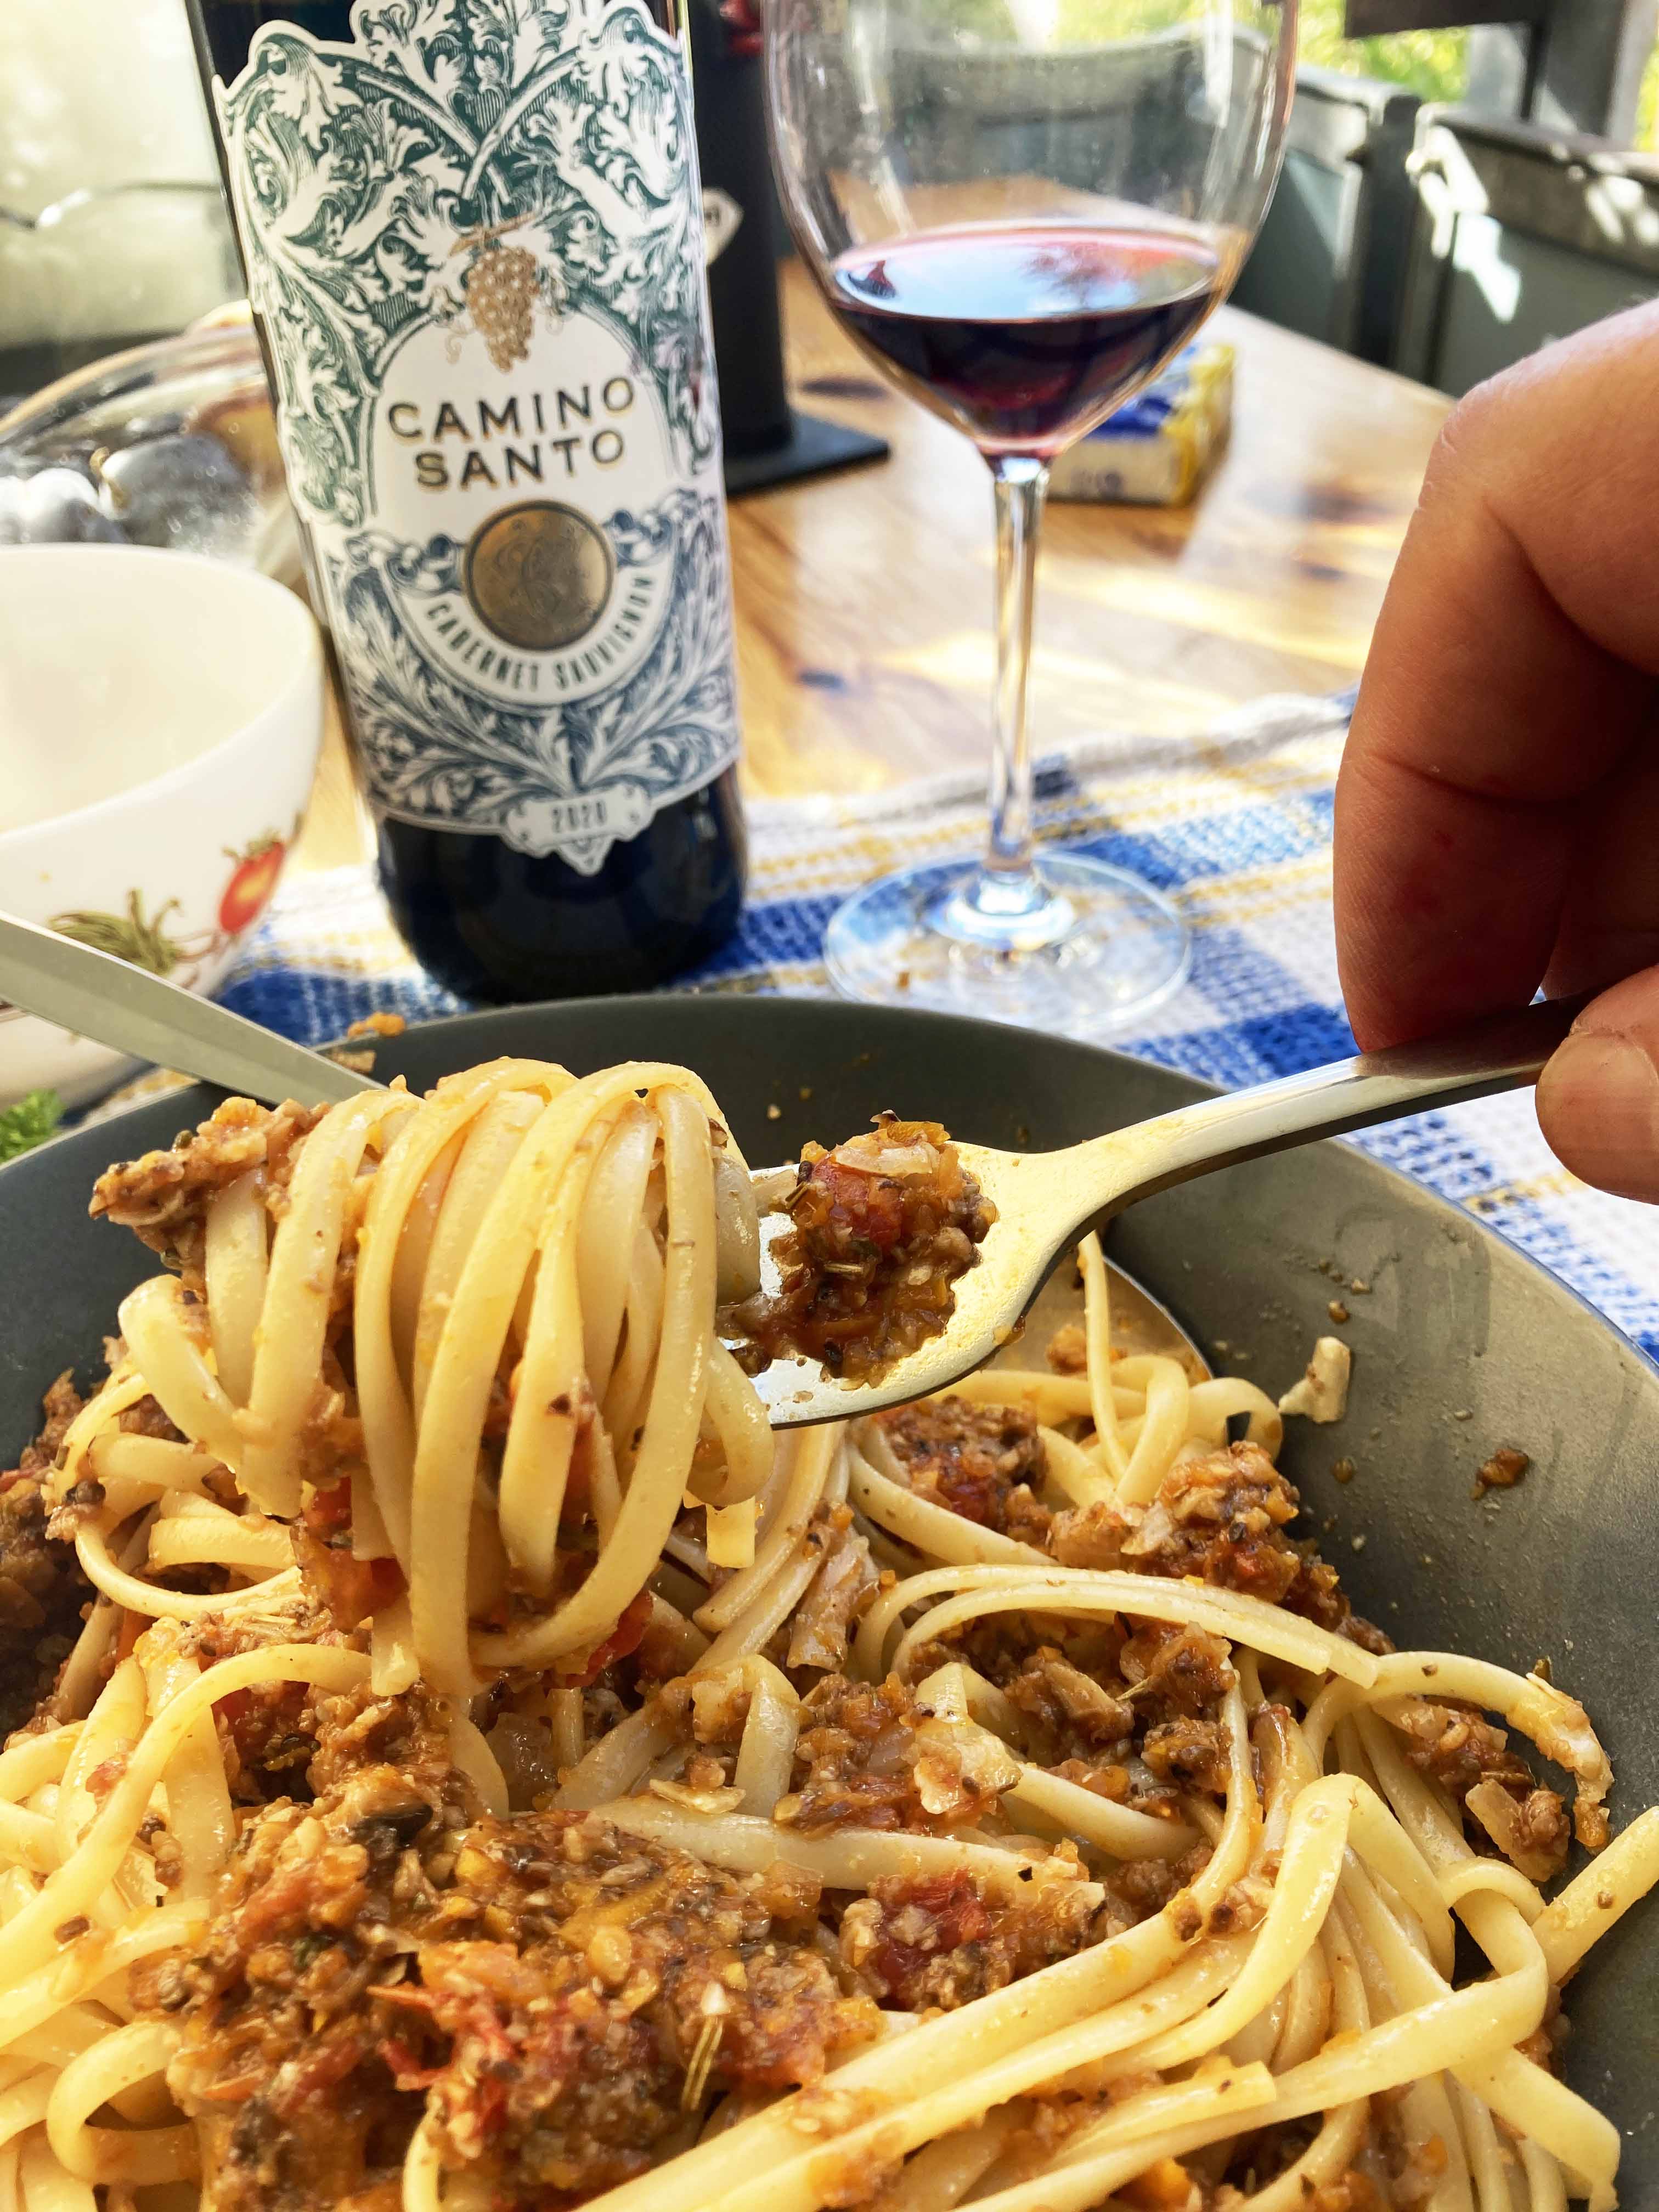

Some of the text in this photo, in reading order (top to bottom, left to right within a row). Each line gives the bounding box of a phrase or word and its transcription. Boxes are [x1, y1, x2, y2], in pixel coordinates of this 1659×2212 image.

[388, 377, 634, 443] CAMINO
[414, 429, 624, 490] SANTO
[426, 574, 658, 692] CABERNET SAUVIGNON
[551, 800, 607, 834] 2020
